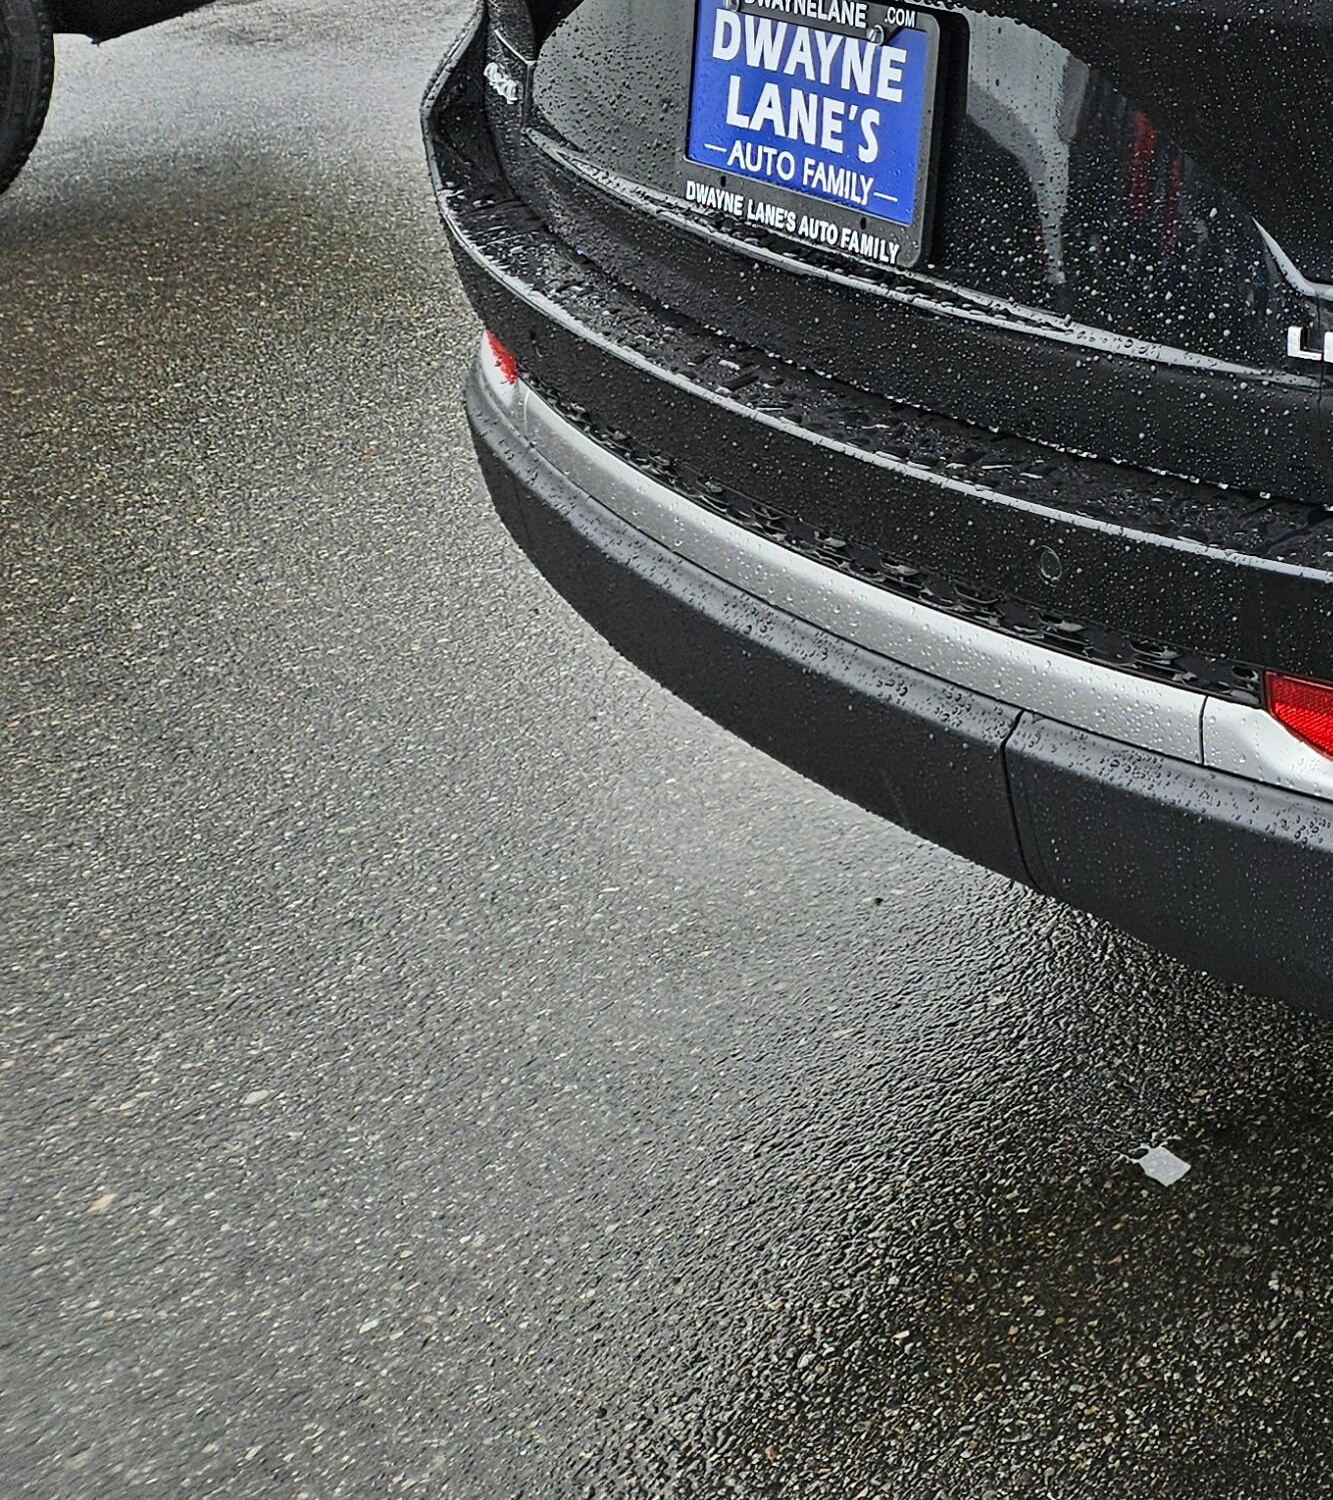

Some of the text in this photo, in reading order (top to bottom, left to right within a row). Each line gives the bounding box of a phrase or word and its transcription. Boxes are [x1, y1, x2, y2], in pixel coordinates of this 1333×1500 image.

[712, 8, 907, 103] DWAYNE
[726, 74, 881, 164] LANE'S
[727, 139, 874, 206] AUTO FAMILY
[685, 180, 900, 265] DWAYNE LANE'S AUTO FAMILY
